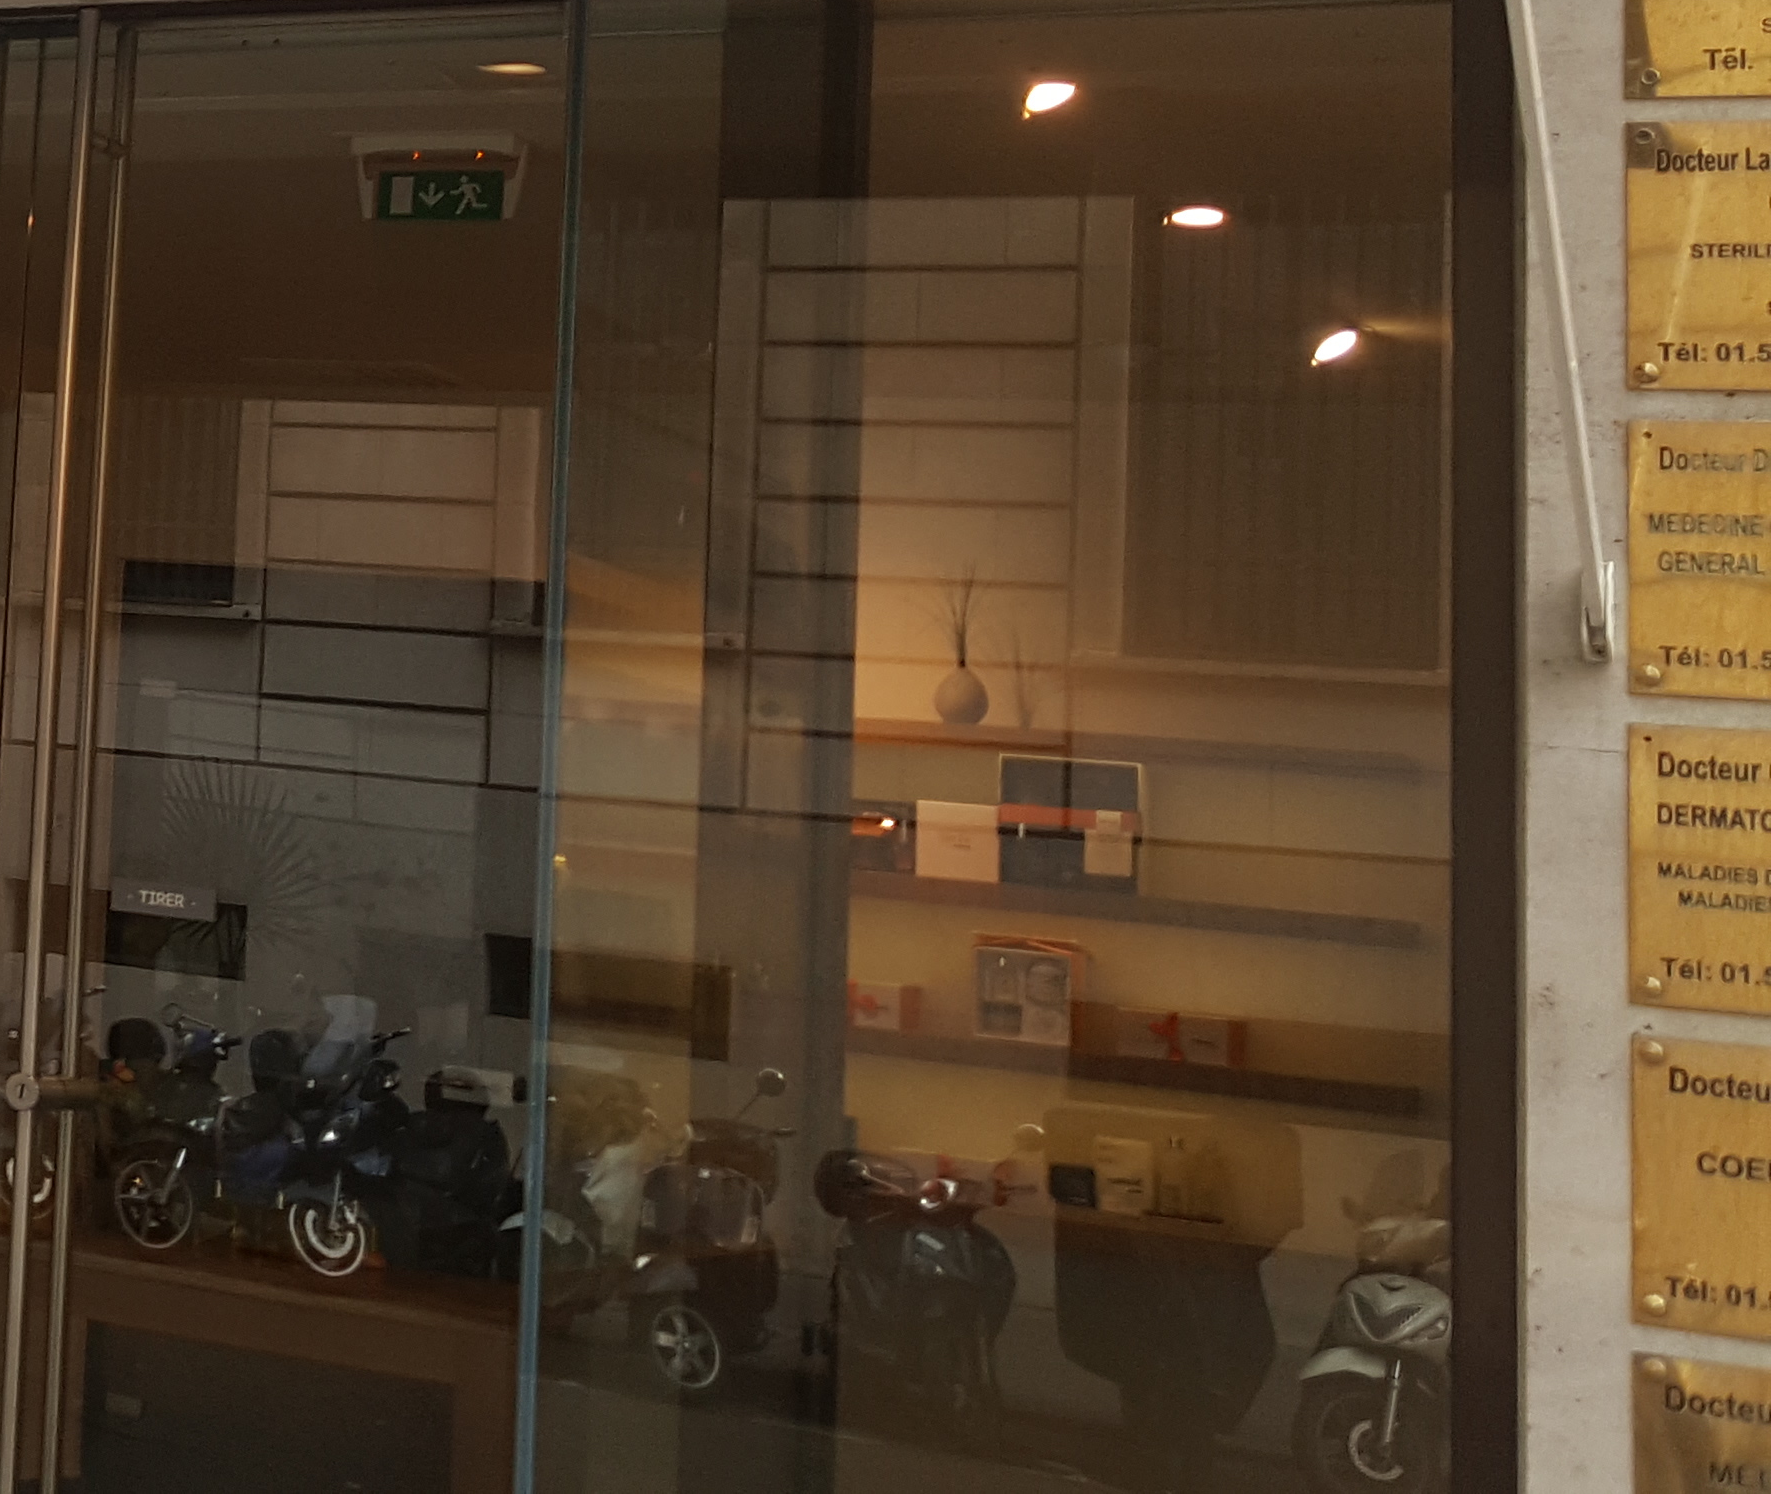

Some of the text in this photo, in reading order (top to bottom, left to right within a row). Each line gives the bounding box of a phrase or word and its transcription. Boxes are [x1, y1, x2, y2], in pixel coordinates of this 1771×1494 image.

[1656, 148, 1738, 172] Docteur
[1659, 446, 1745, 473] Docteur
[1658, 550, 1765, 576] GENERAL
[1657, 751, 1761, 783] Docteur
[1658, 861, 1758, 885] MALADIES
[139, 889, 184, 908] TIRER
[1669, 1066, 1771, 1103] Docteu
[1697, 1151, 1771, 1182] COE
[1726, 1284, 1771, 1310] 01.
